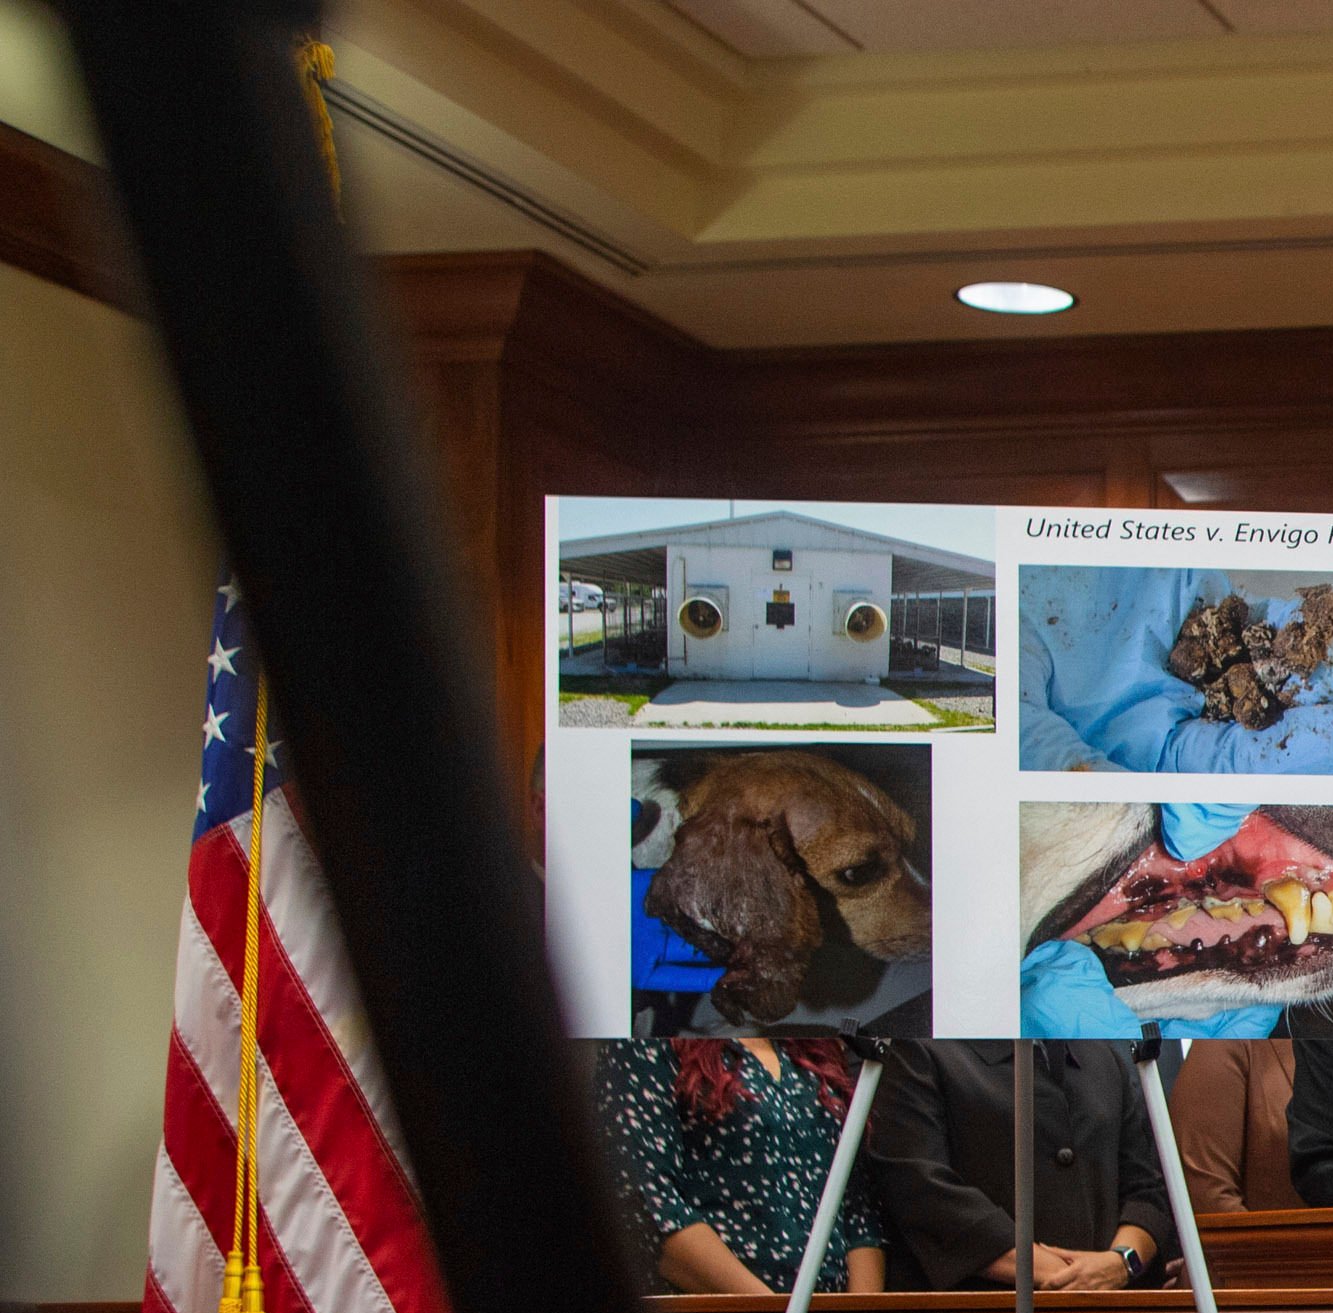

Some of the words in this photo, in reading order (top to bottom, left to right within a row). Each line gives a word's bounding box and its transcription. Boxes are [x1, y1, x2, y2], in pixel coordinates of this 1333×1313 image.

[1025, 517, 1112, 540] United
[1119, 519, 1197, 541] States
[1205, 526, 1224, 542] v.
[1234, 522, 1319, 549] Envigo
